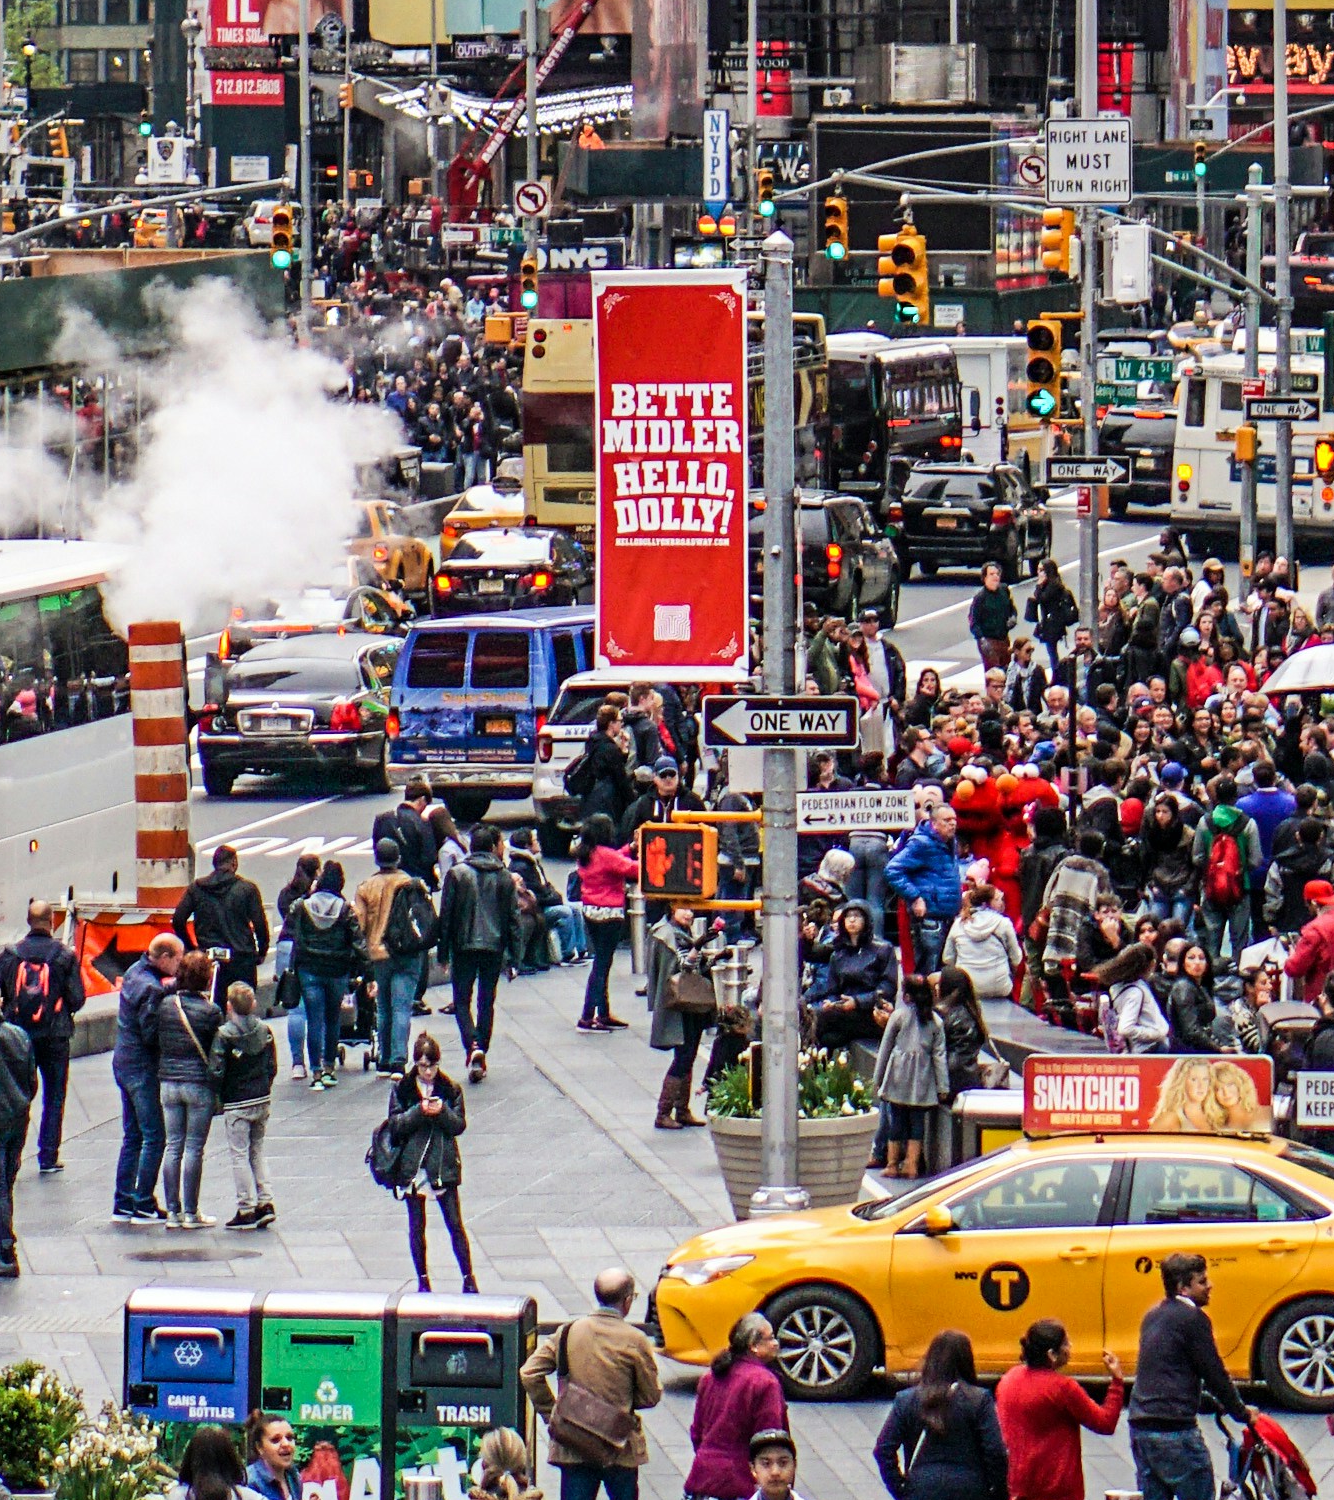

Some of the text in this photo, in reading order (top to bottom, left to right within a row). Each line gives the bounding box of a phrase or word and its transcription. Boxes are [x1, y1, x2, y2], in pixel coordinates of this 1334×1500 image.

[216, 28, 243, 44] TIMES
[1050, 130, 1128, 145] RIGHT LANE
[708, 114, 721, 197] NYPD
[1066, 153, 1111, 170] MUST
[1049, 179, 1129, 192] TURN RIGHT
[549, 248, 609, 268] NYC
[1308, 336, 1322, 351] W
[1118, 361, 1156, 379] W 45
[610, 382, 734, 418] BETTE
[1256, 404, 1309, 416] ONE WAY
[602, 420, 742, 454] MIDLER
[613, 461, 736, 501] HELLO,
[613, 498, 734, 536] DOLLY!
[615, 537, 731, 547] HELLODOLLYONBROADWAY.COM
[750, 712, 842, 732] ONE WAY
[801, 796, 909, 810] PEDESTRIAN FLOW ZONE
[850, 810, 910, 824] KEEP MOVING
[1033, 1075, 1141, 1112] SNATCHED
[954, 1271, 978, 1280] NYC
[990, 1270, 1020, 1307] T
[167, 1394, 207, 1407] CANS &
[188, 1405, 236, 1419] BOTTLES
[300, 1404, 353, 1421] PAPER
[436, 1405, 491, 1423] TRASH
